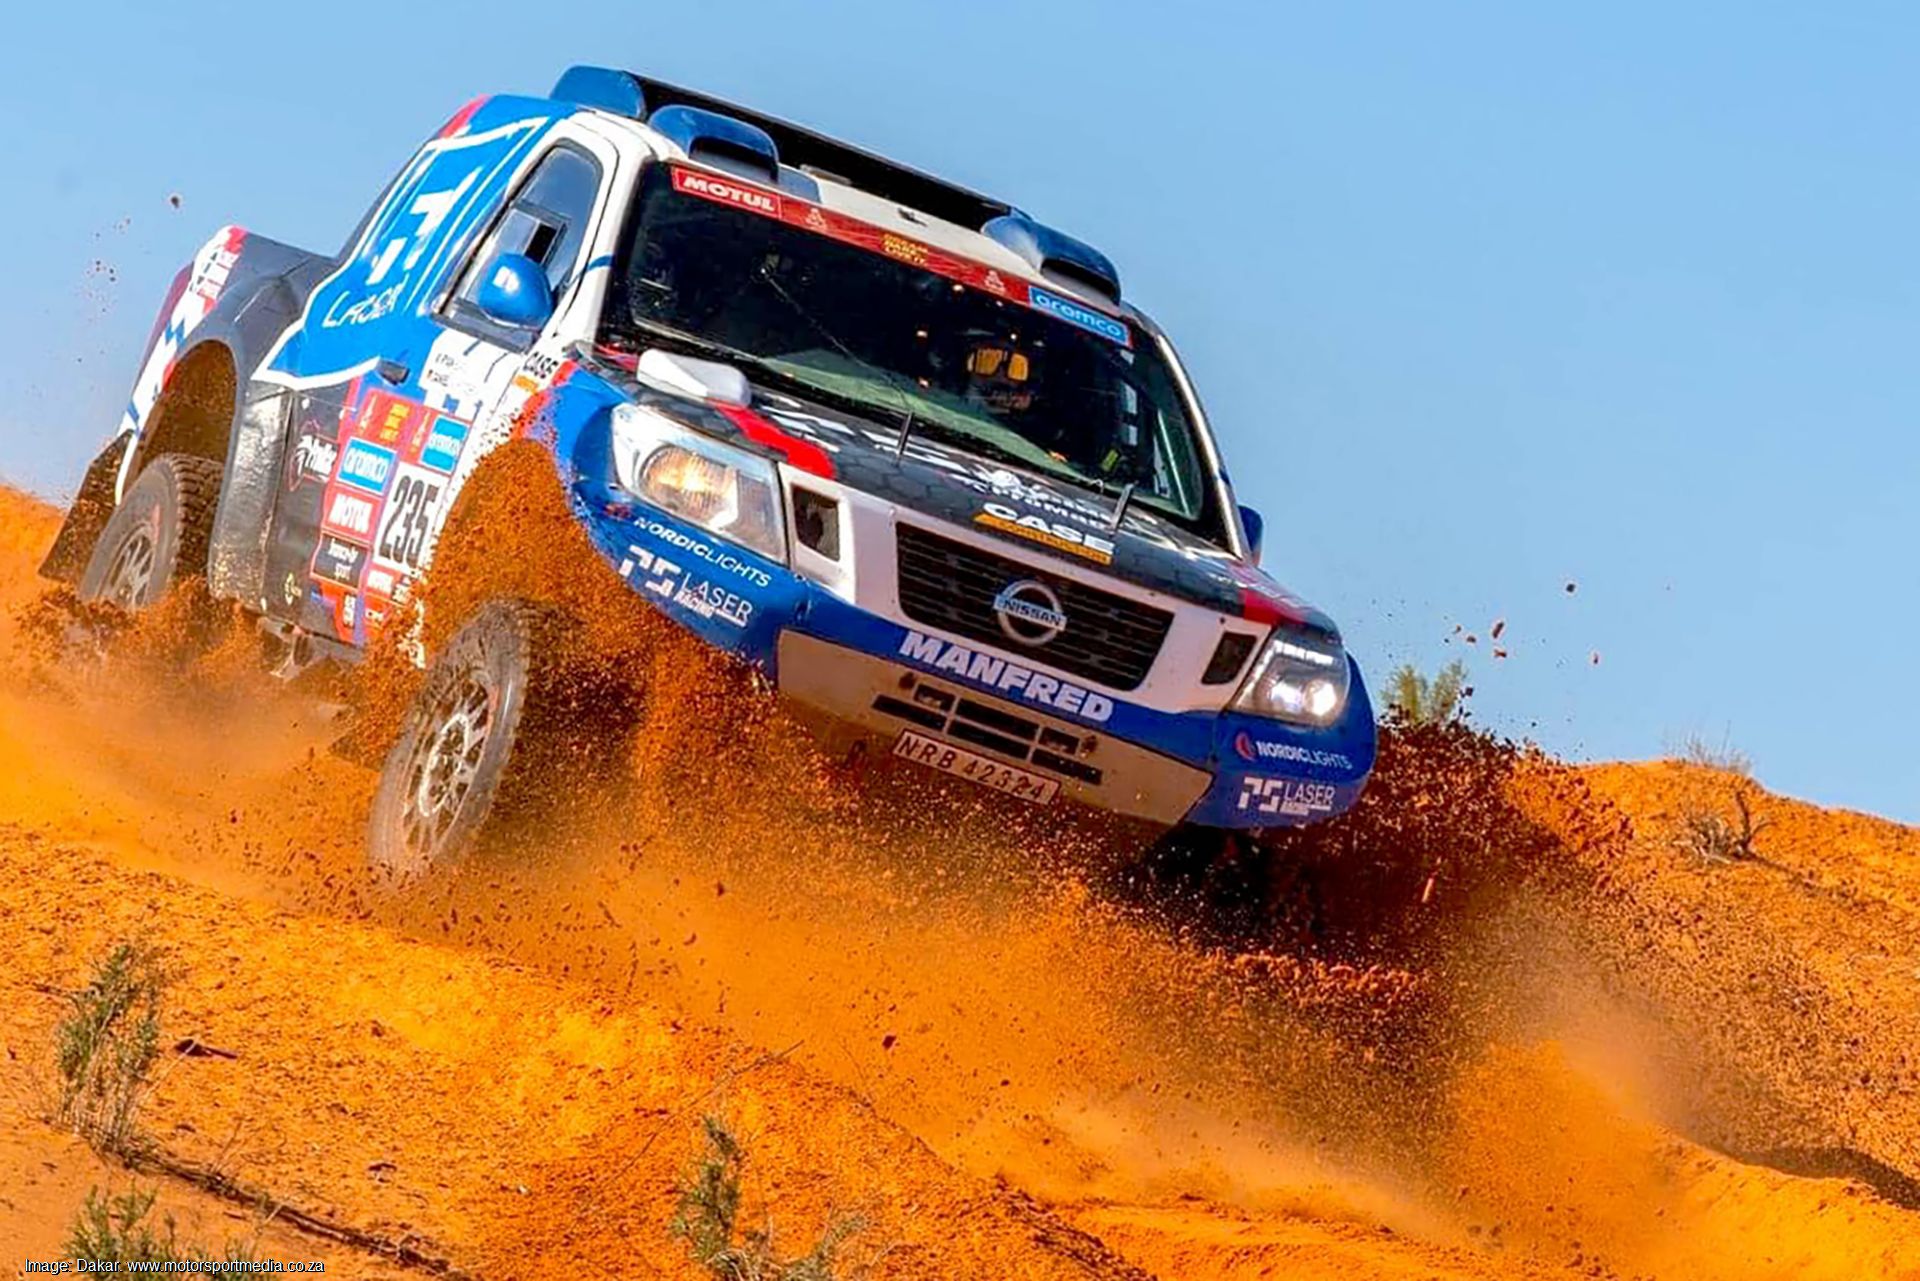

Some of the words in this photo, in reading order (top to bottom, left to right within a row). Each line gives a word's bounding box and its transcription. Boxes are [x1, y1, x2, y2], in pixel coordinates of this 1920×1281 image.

[682, 174, 776, 212] MOTUL
[1035, 292, 1124, 339] aramco
[379, 475, 439, 569] 235
[982, 502, 1115, 555] CASE
[633, 517, 772, 587] NORDICLIGHTS
[680, 572, 753, 623] LASER
[1001, 599, 1062, 628] NISSAN
[900, 632, 1114, 722] MANFRED
[899, 735, 957, 768] NRB
[1256, 741, 1352, 770] NORDICLIGHTS
[1284, 783, 1336, 805] LASER
